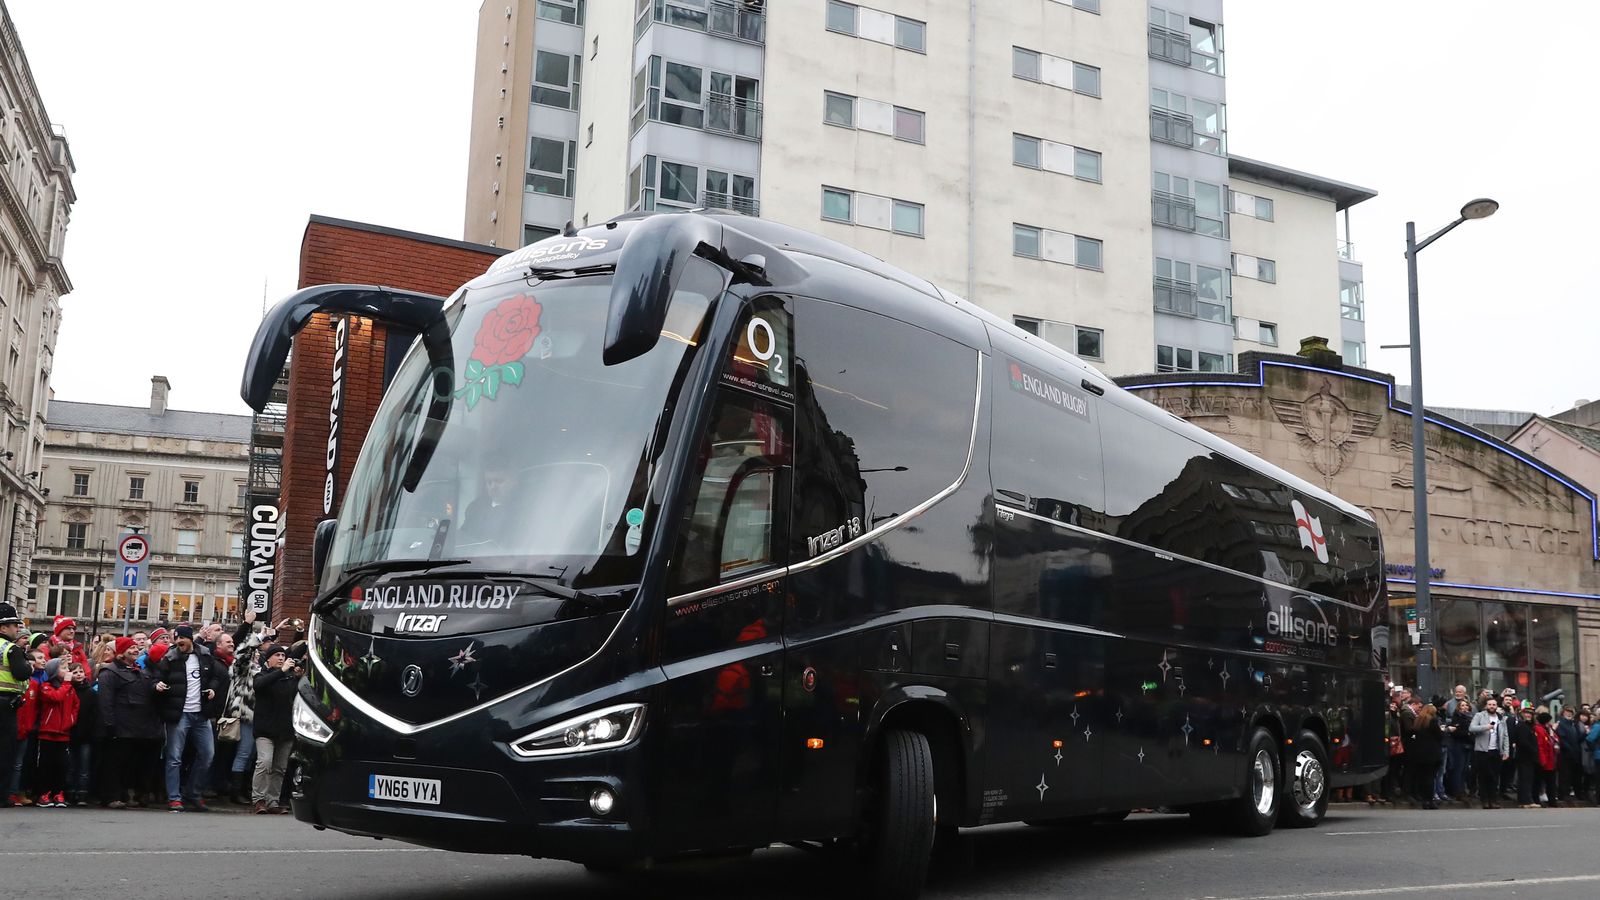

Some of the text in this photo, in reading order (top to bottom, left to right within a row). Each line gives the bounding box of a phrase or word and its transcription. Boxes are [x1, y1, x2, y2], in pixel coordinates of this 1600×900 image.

[1022, 373, 1087, 416] ENGLAND RUGBY
[807, 516, 861, 557] Irizar i8
[1459, 518, 1573, 555] GARAGE
[253, 594, 265, 609] BAR
[361, 584, 521, 610] ENGLAND RUGBY
[675, 579, 780, 616] www.ellisonstravel.com
[394, 612, 448, 633] Irizar
[1266, 604, 1338, 647] ellisons
[377, 778, 438, 802] YN66 VYA
